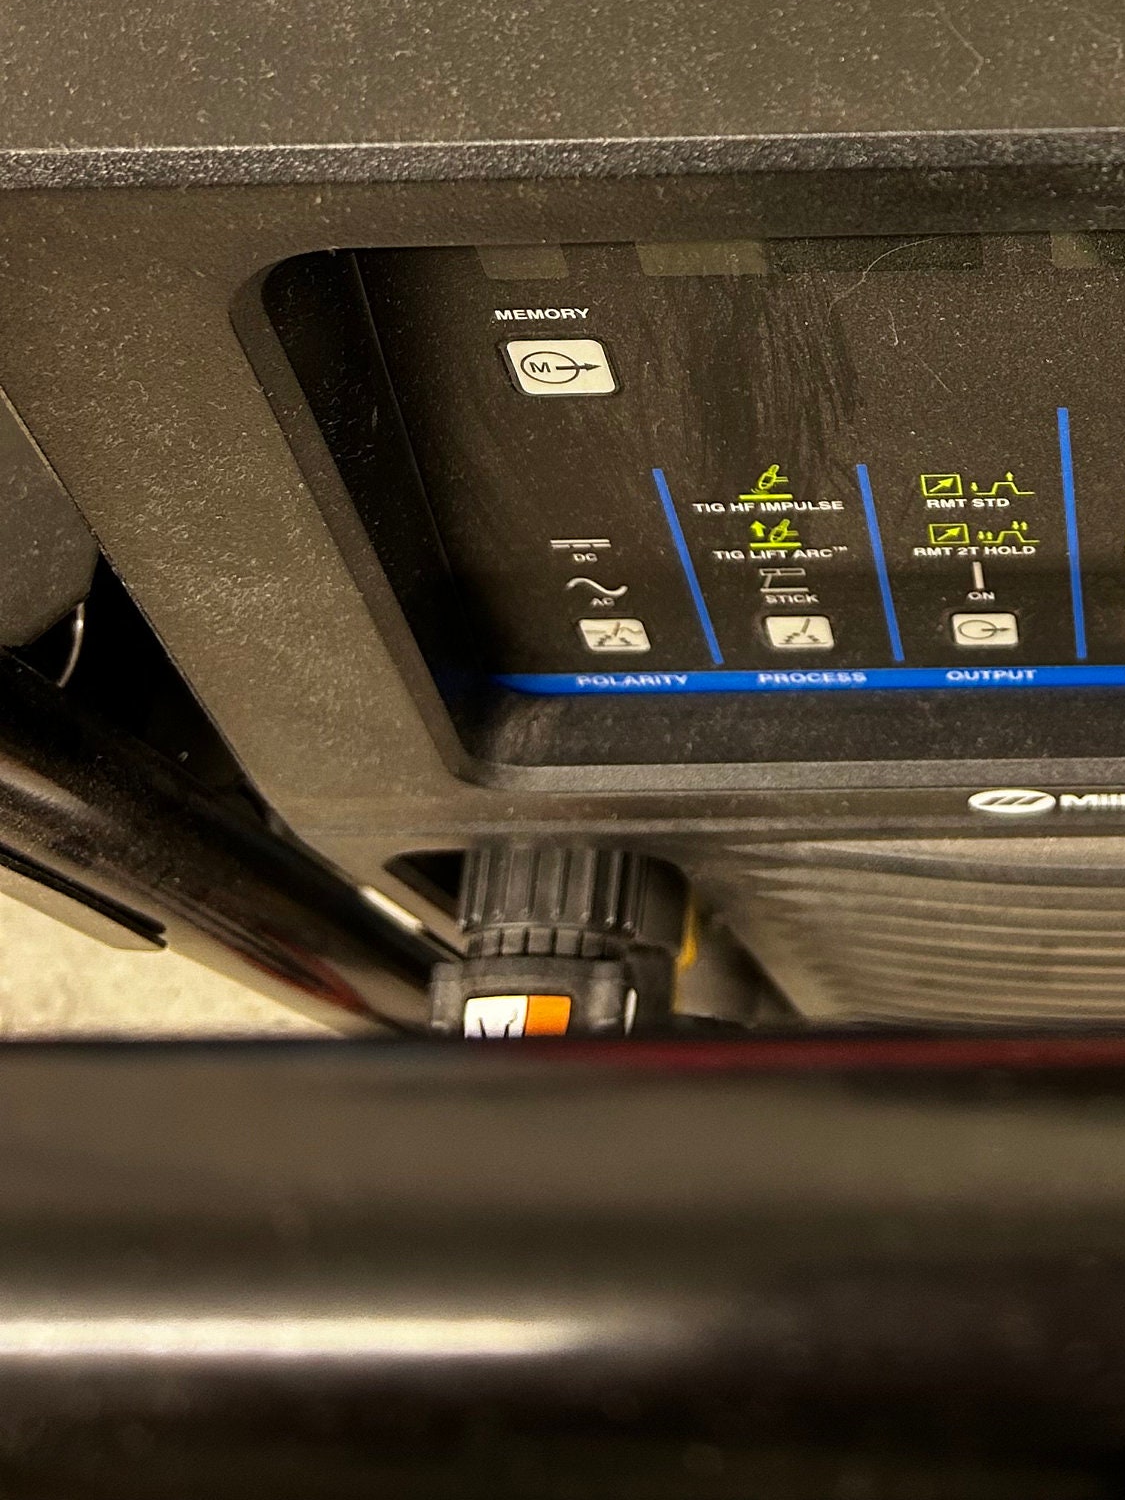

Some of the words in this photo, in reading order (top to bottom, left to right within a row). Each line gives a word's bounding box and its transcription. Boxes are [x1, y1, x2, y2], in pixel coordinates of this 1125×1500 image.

[494, 308, 589, 320] MEMORY
[529, 361, 551, 373] M
[692, 502, 726, 513] TIG
[730, 501, 755, 512] HF
[760, 500, 845, 512] IMPULSE
[926, 498, 967, 509] RMT
[972, 498, 1010, 508] STD
[712, 550, 745, 560] TIG
[749, 549, 788, 560] LIFT
[913, 546, 953, 557] RMT
[957, 546, 980, 556] 2T
[984, 545, 1036, 556] HOLD
[589, 596, 615, 607] AC
[764, 594, 820, 604] STICK
[967, 591, 995, 601] ON
[576, 674, 688, 687] POLARITY
[757, 671, 868, 685] PROCESS
[945, 668, 1038, 682] OUTPUT
